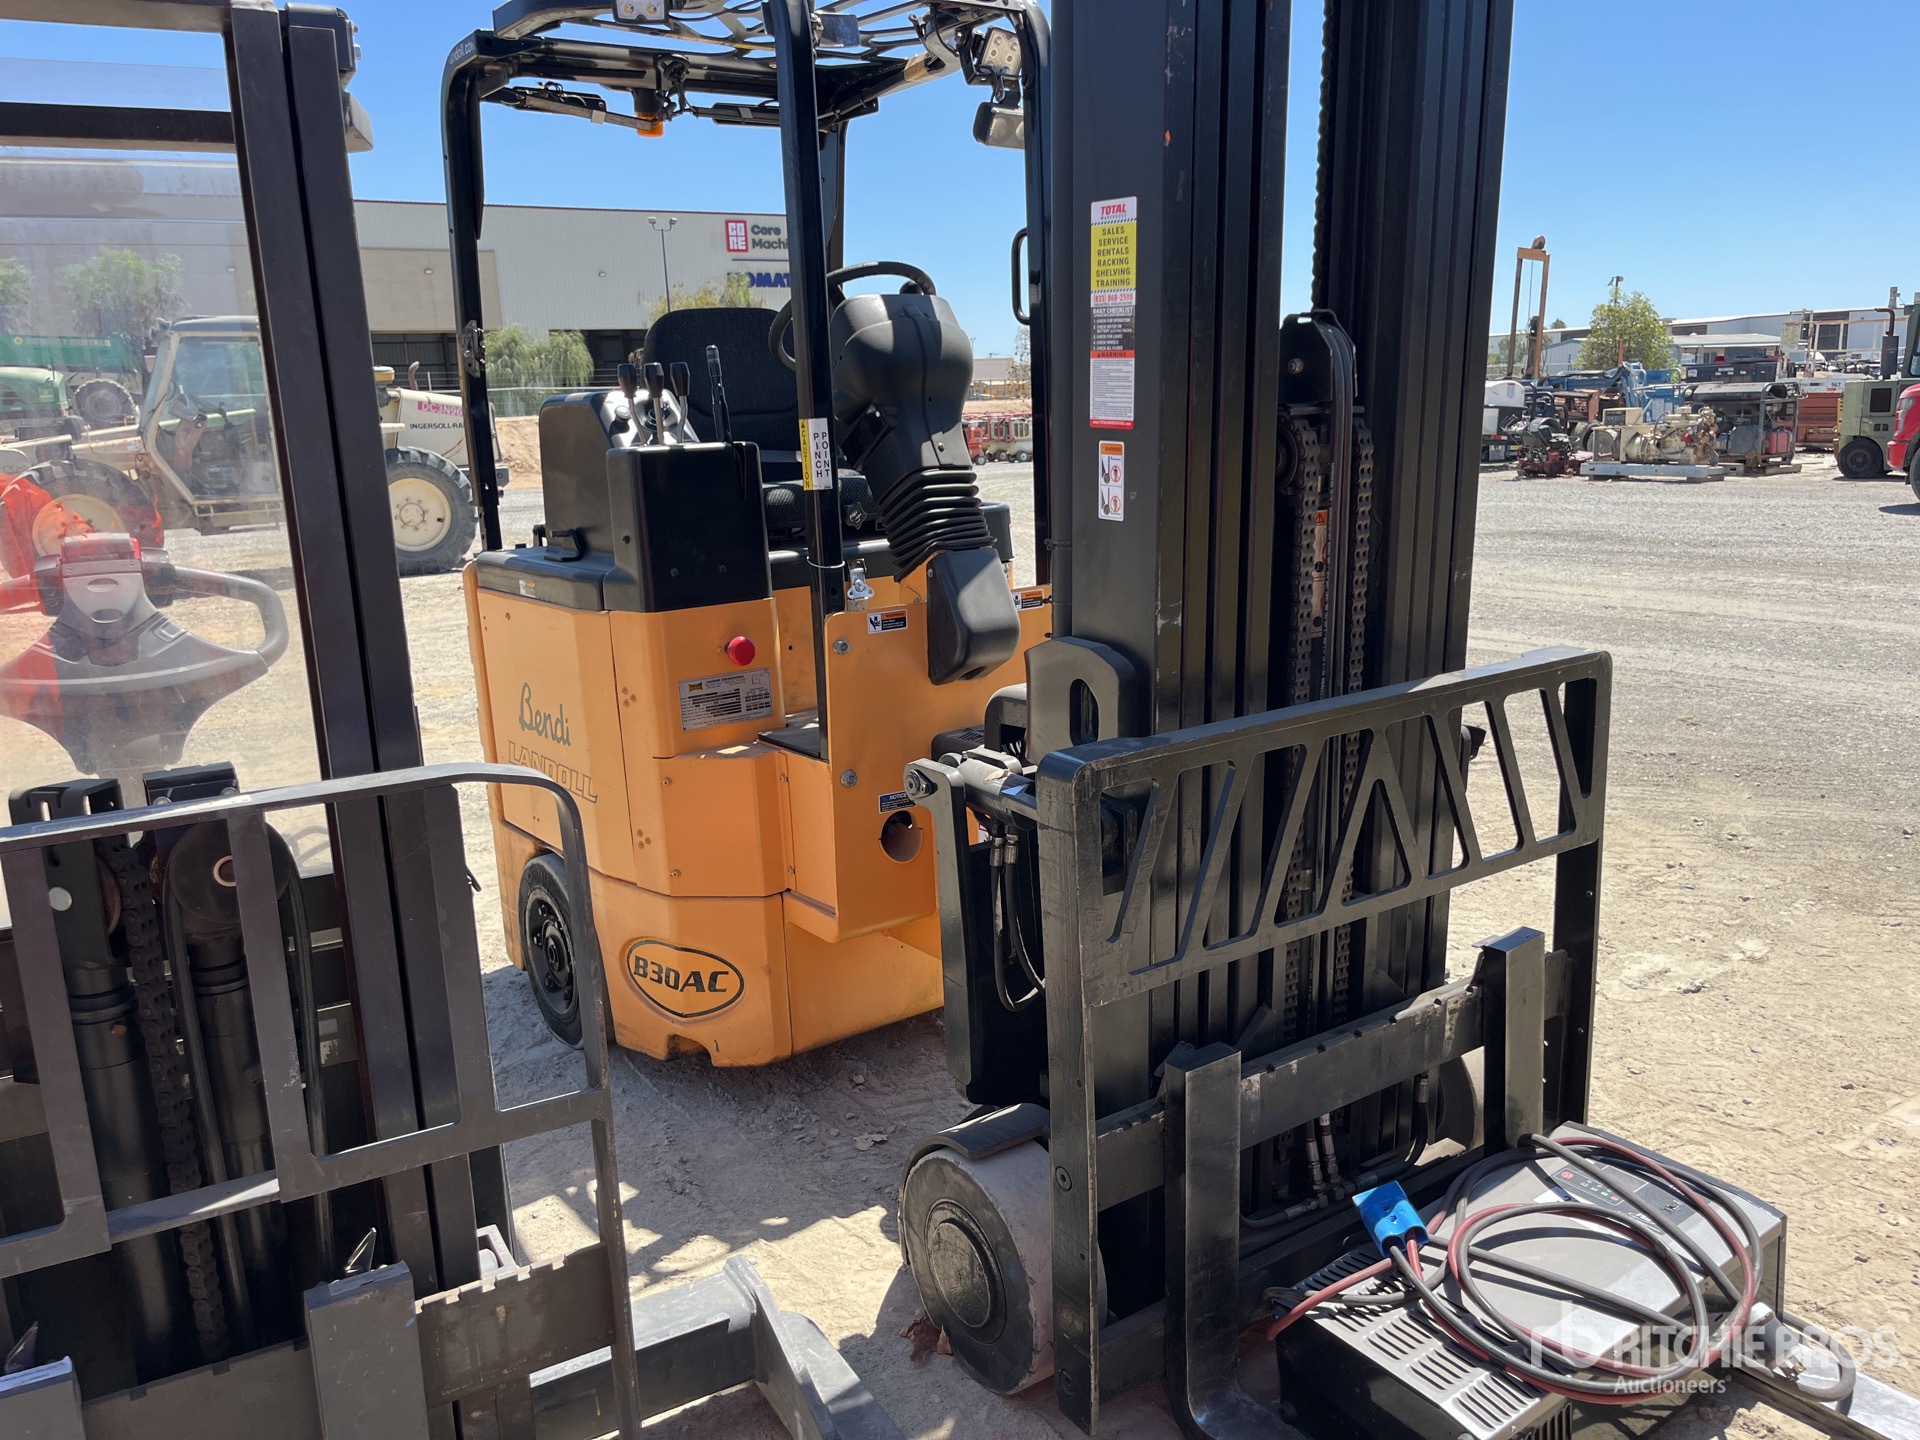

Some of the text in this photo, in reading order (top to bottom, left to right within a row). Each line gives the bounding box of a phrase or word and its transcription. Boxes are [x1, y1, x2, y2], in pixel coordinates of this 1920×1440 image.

[1101, 204, 1127, 215] TOTAL
[751, 225, 781, 235] Core
[1102, 227, 1125, 236] SALES
[1099, 236, 1128, 246] SERVICE
[1098, 247, 1129, 257] RENTALS
[1098, 258, 1129, 267] RACKING
[1096, 268, 1130, 277] SHELVING
[1096, 278, 1130, 287] TRAINING
[1094, 294, 1106, 303] (833)
[801, 430, 810, 489] CAUTION
[813, 432, 823, 478] PINCH
[821, 432, 830, 477] POINT
[519, 682, 571, 747] Bendi
[633, 955, 730, 993] B30AC
